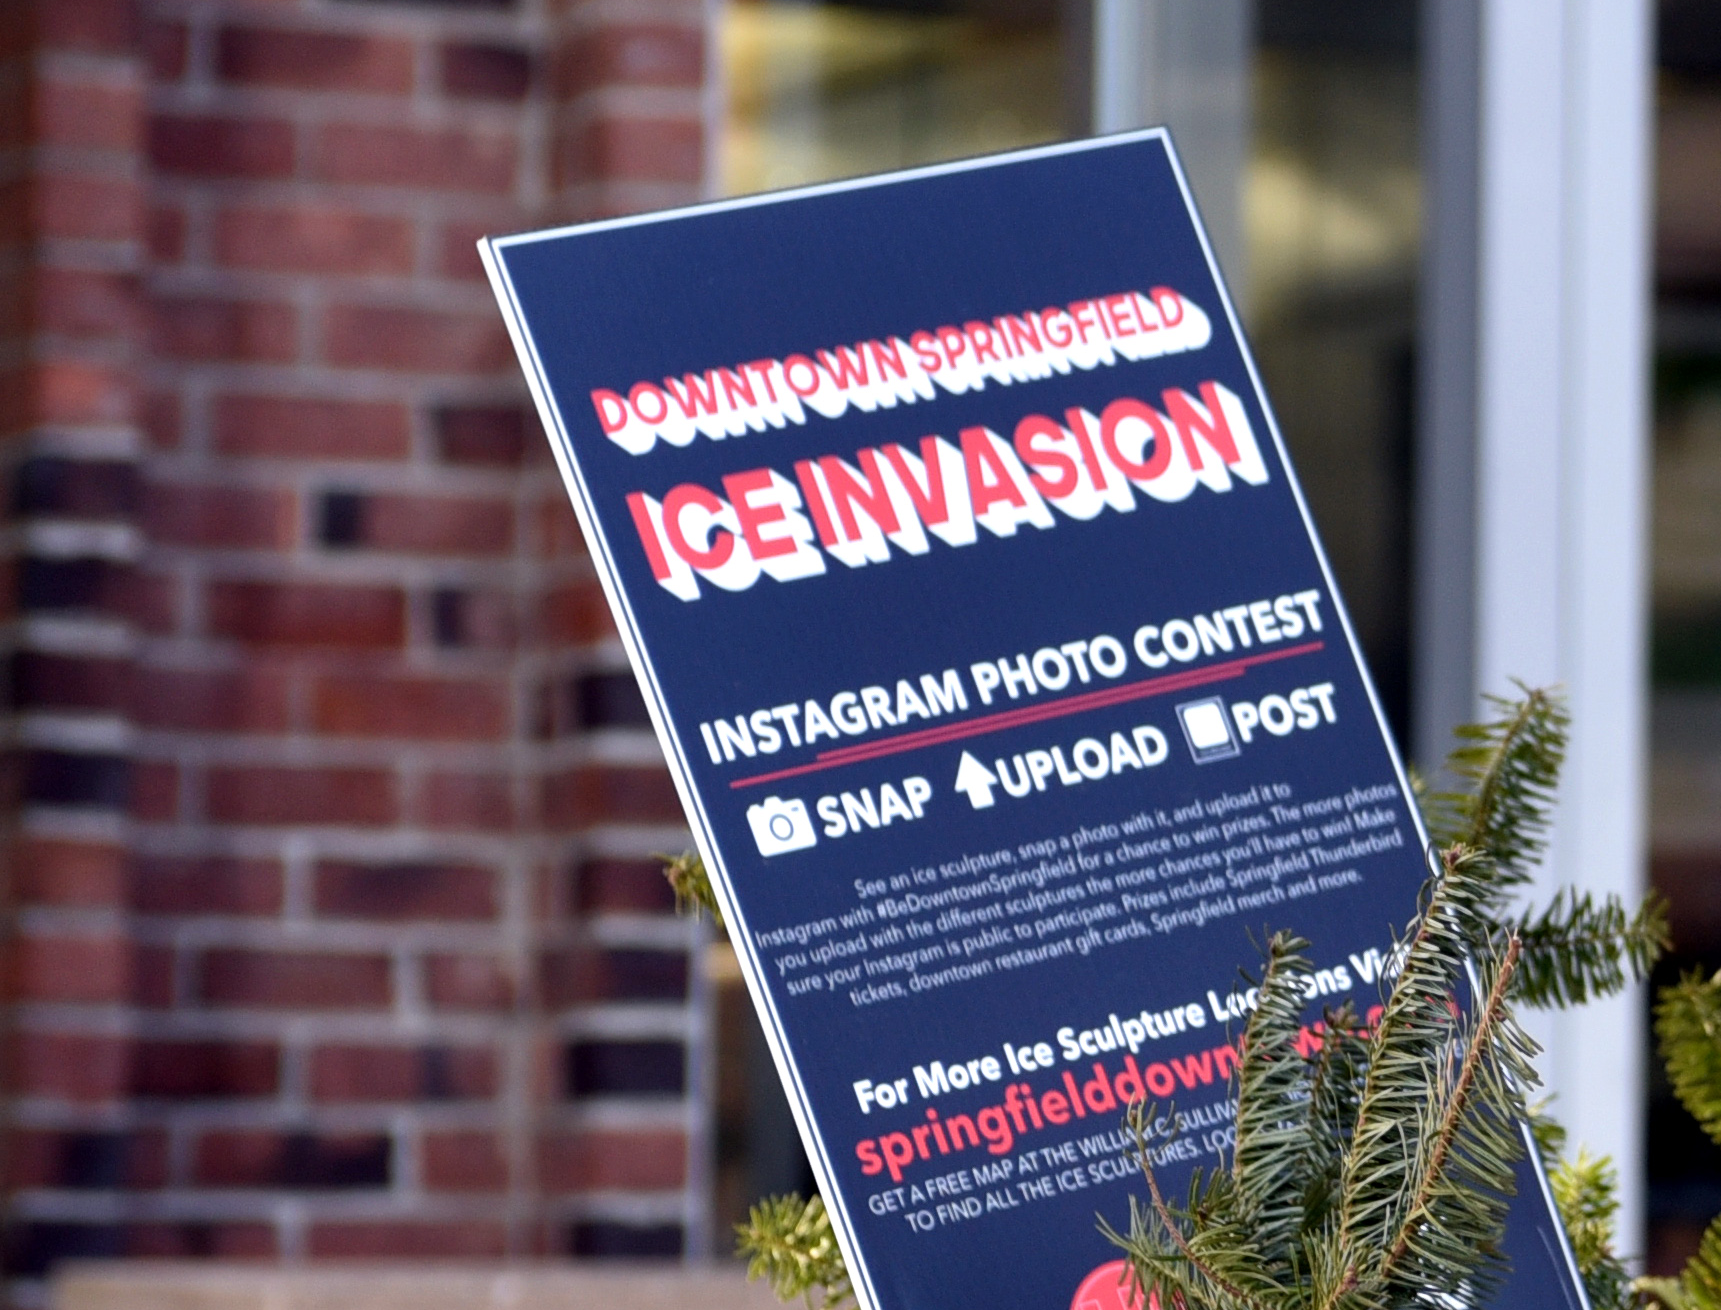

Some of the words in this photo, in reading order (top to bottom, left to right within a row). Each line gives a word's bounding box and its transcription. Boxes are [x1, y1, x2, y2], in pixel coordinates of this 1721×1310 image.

[591, 338, 915, 442] DOWNTOWN
[910, 287, 1191, 379] SPRINGFIELD
[627, 469, 806, 588] ICE
[795, 382, 1249, 554] INVASION
[699, 668, 969, 765] INSTAGRAM
[969, 634, 1128, 706] PHOTO
[1133, 588, 1323, 669] CONTEST
[816, 776, 933, 839] SNAP
[994, 725, 1169, 798] UPLOAD
[1230, 681, 1337, 743] POST
[754, 918, 838, 948] Instagram
[839, 906, 875, 929] with
[876, 855, 1077, 918] #BeDowntownSpringfield
[1076, 853, 1100, 870] for
[1104, 852, 1114, 865] a
[1116, 838, 1171, 862] chance
[1172, 834, 1191, 848] to
[1192, 827, 1220, 843] win
[1221, 815, 1271, 841] prizes.
[1270, 805, 1301, 823] The
[1302, 797, 1342, 816] more
[1344, 785, 1397, 811] photos
[775, 953, 807, 976] you
[809, 933, 868, 964] upload
[869, 925, 905, 948] with
[905, 920, 933, 938] the
[936, 903, 1003, 931] different
[1005, 885, 1085, 915] sculptures
[1085, 877, 1113, 894] the
[1115, 868, 1156, 887] more
[1158, 852, 1221, 877] chances
[1222, 837, 1263, 866] you'll
[1262, 832, 1301, 851] have
[1301, 828, 1320, 842] to
[1321, 816, 1353, 838] win!
[1353, 808, 1395, 829] Make
[786, 976, 822, 995] sure
[824, 965, 860, 990] your
[863, 945, 944, 975] Instagram
[946, 941, 961, 955] is
[962, 926, 1013, 956] public
[1013, 924, 1033, 939] to
[1034, 903, 1121, 938] participate.
[1121, 891, 1168, 912] Prizes
[1169, 874, 1225, 900] include
[1225, 851, 1310, 888] Springfield
[1309, 828, 1403, 865] Thunderbird
[854, 879, 886, 898] See
[890, 875, 911, 890] an
[912, 869, 937, 884] ice
[939, 850, 1016, 878] sculpture,
[1018, 840, 1057, 859] snap
[1060, 836, 1070, 849] a
[1071, 825, 1119, 850] photo
[1121, 813, 1154, 835] with
[1156, 811, 1171, 826] it,
[1174, 800, 1204, 822] and
[1205, 787, 1259, 816] upload
[1261, 786, 1272, 801] it
[1272, 784, 1291, 798] to
[849, 982, 907, 1006] tickets,
[908, 960, 993, 991] downtown
[995, 938, 1074, 969] restaurant
[1075, 929, 1103, 955] gift
[1104, 919, 1151, 943] cards,
[1150, 895, 1236, 933] Springfield
[1237, 884, 1285, 909] merch
[1287, 875, 1317, 898] and
[1318, 870, 1361, 889] more.
[852, 1077, 909, 1115] For
[912, 1055, 1002, 1099] More
[1002, 1041, 1055, 1075] Ice
[1056, 1002, 1207, 1062] Sculpture
[1206, 964, 1353, 1024] Locons
[868, 1187, 905, 1215] GET
[911, 1184, 926, 1204] A
[924, 1170, 972, 1199] FREE
[971, 1158, 1013, 1186] MAP
[1018, 1151, 1039, 1175] AT
[1040, 1141, 1078, 1167] THE
[1174, 1094, 1246, 1132] SULLIV
[904, 1209, 935, 1232] TO
[935, 1196, 982, 1225] FIND
[986, 1188, 1019, 1212] ALL
[1017, 1176, 1056, 1201] THE
[1055, 1167, 1096, 1198] ICE
